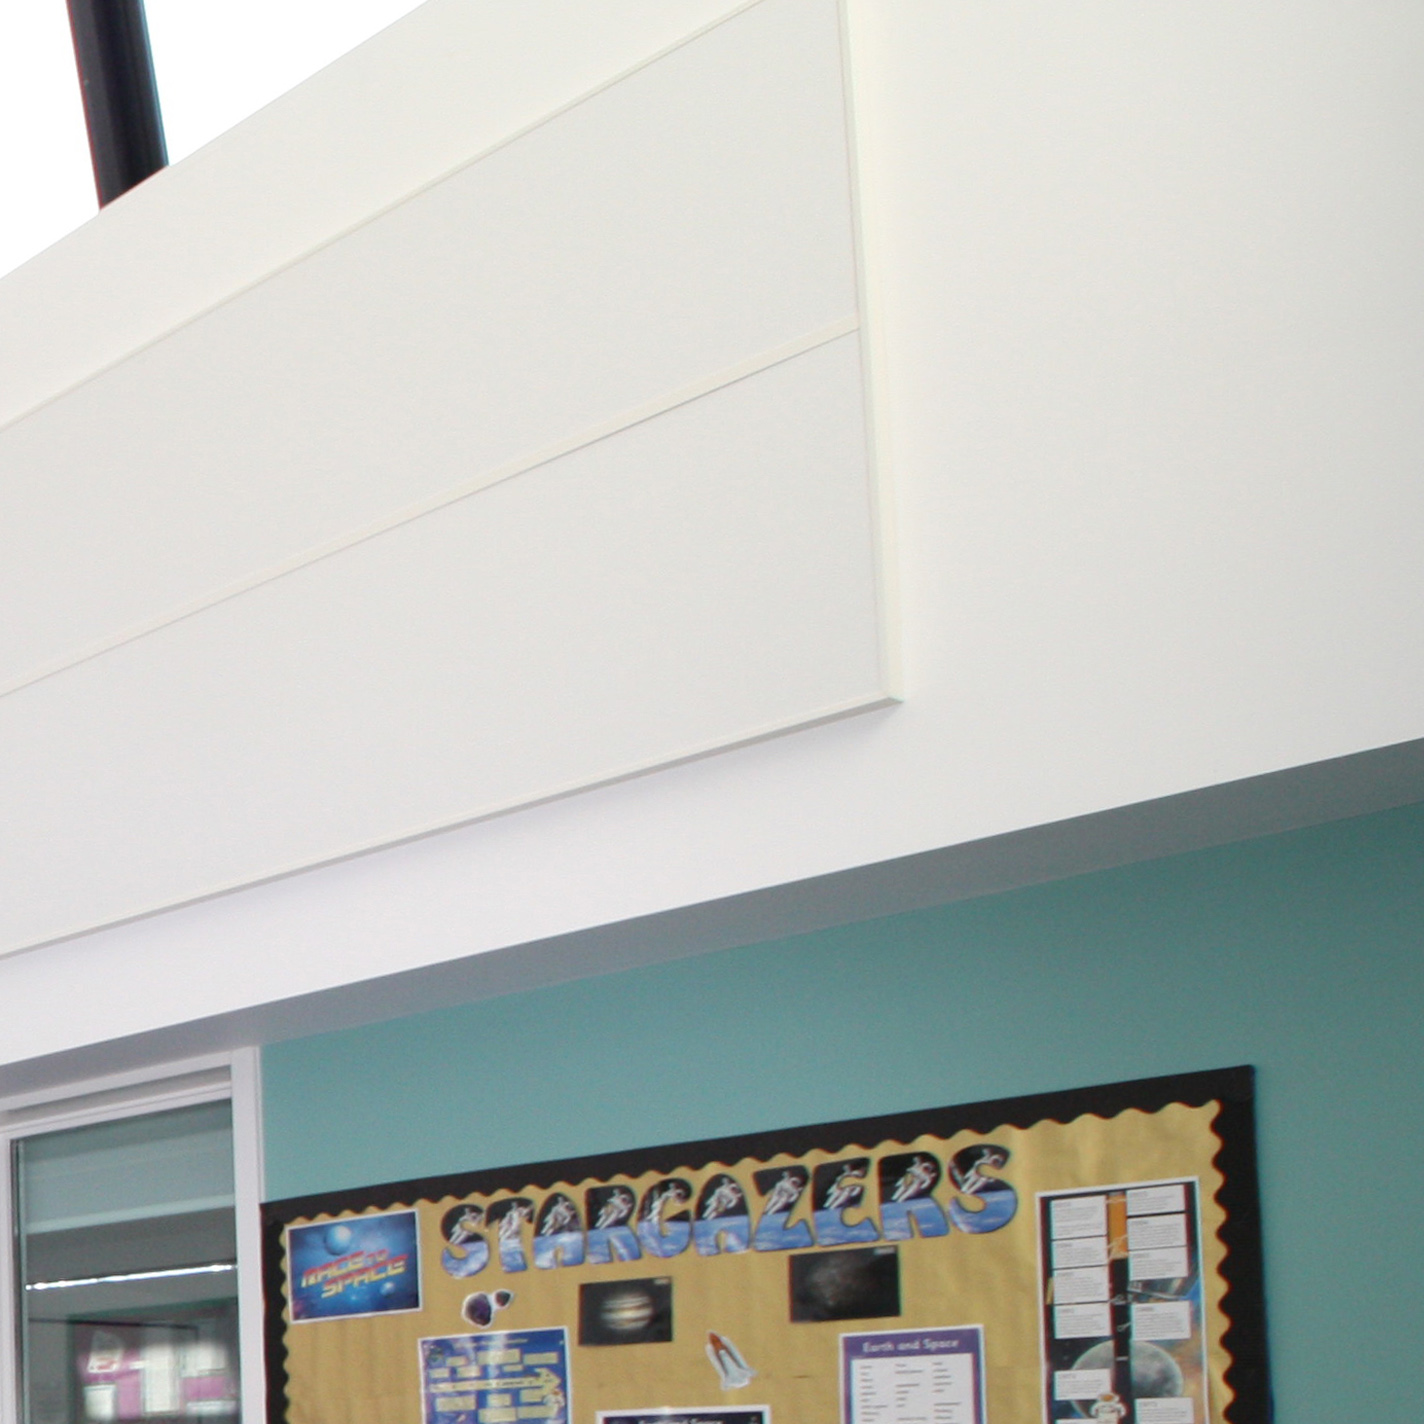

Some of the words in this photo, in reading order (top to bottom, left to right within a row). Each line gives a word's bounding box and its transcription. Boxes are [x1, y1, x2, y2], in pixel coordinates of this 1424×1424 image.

[441, 1144, 1018, 1279] STARGAZERS
[301, 1250, 366, 1288] RACE
[321, 1254, 409, 1299] SPACE
[862, 1341, 895, 1353] Earth
[897, 1339, 921, 1351] and
[923, 1338, 960, 1353] Space
